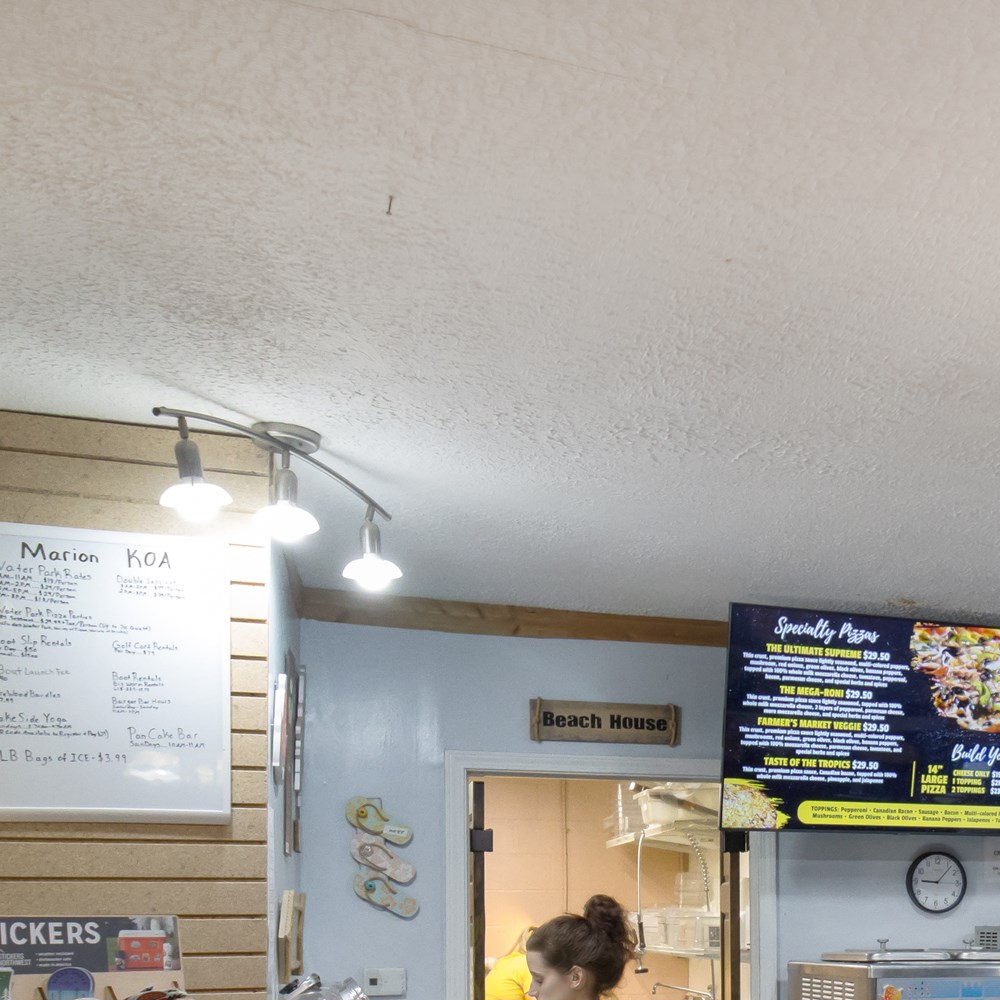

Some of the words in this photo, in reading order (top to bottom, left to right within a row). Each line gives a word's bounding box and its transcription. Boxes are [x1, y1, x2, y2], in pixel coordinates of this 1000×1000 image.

[21, 542, 99, 563] Marion
[127, 548, 171, 569] KOA
[38, 565, 61, 578] Park
[26, 607, 42, 617] Park
[774, 616, 837, 645] Specialty
[839, 622, 879, 644] Pizzas
[766, 643, 782, 652] THE
[784, 645, 823, 656] ULTIMATE
[825, 648, 862, 659] SUPREME
[863, 650, 890, 661] $29.50
[780, 685, 796, 695] THE
[797, 687, 844, 698] MEGA-RONI
[845, 689, 873, 700] $29.50
[542, 712, 602, 728] Beach
[609, 714, 668, 731] House
[757, 717, 798, 727] FARMER'S
[800, 719, 832, 730] MARKET
[833, 721, 861, 731] VEGGIE
[862, 722, 889, 732] $29.50
[178, 728, 198, 740] Bar
[25, 750, 53, 766] Bags
[58, 753, 66, 761] of
[951, 744, 987, 762] Build
[764, 757, 788, 766] TASTE
[789, 758, 800, 767] OF
[801, 758, 817, 767] THE
[818, 760, 850, 769] TROPICS
[852, 761, 879, 770] $29.50
[921, 775, 948, 784] LARGE
[953, 769, 974, 777] CHEESE
[921, 785, 947, 794] PIZZA
[957, 786, 986, 794] TOPPINGS
[0, 922, 101, 945] ICKERS
